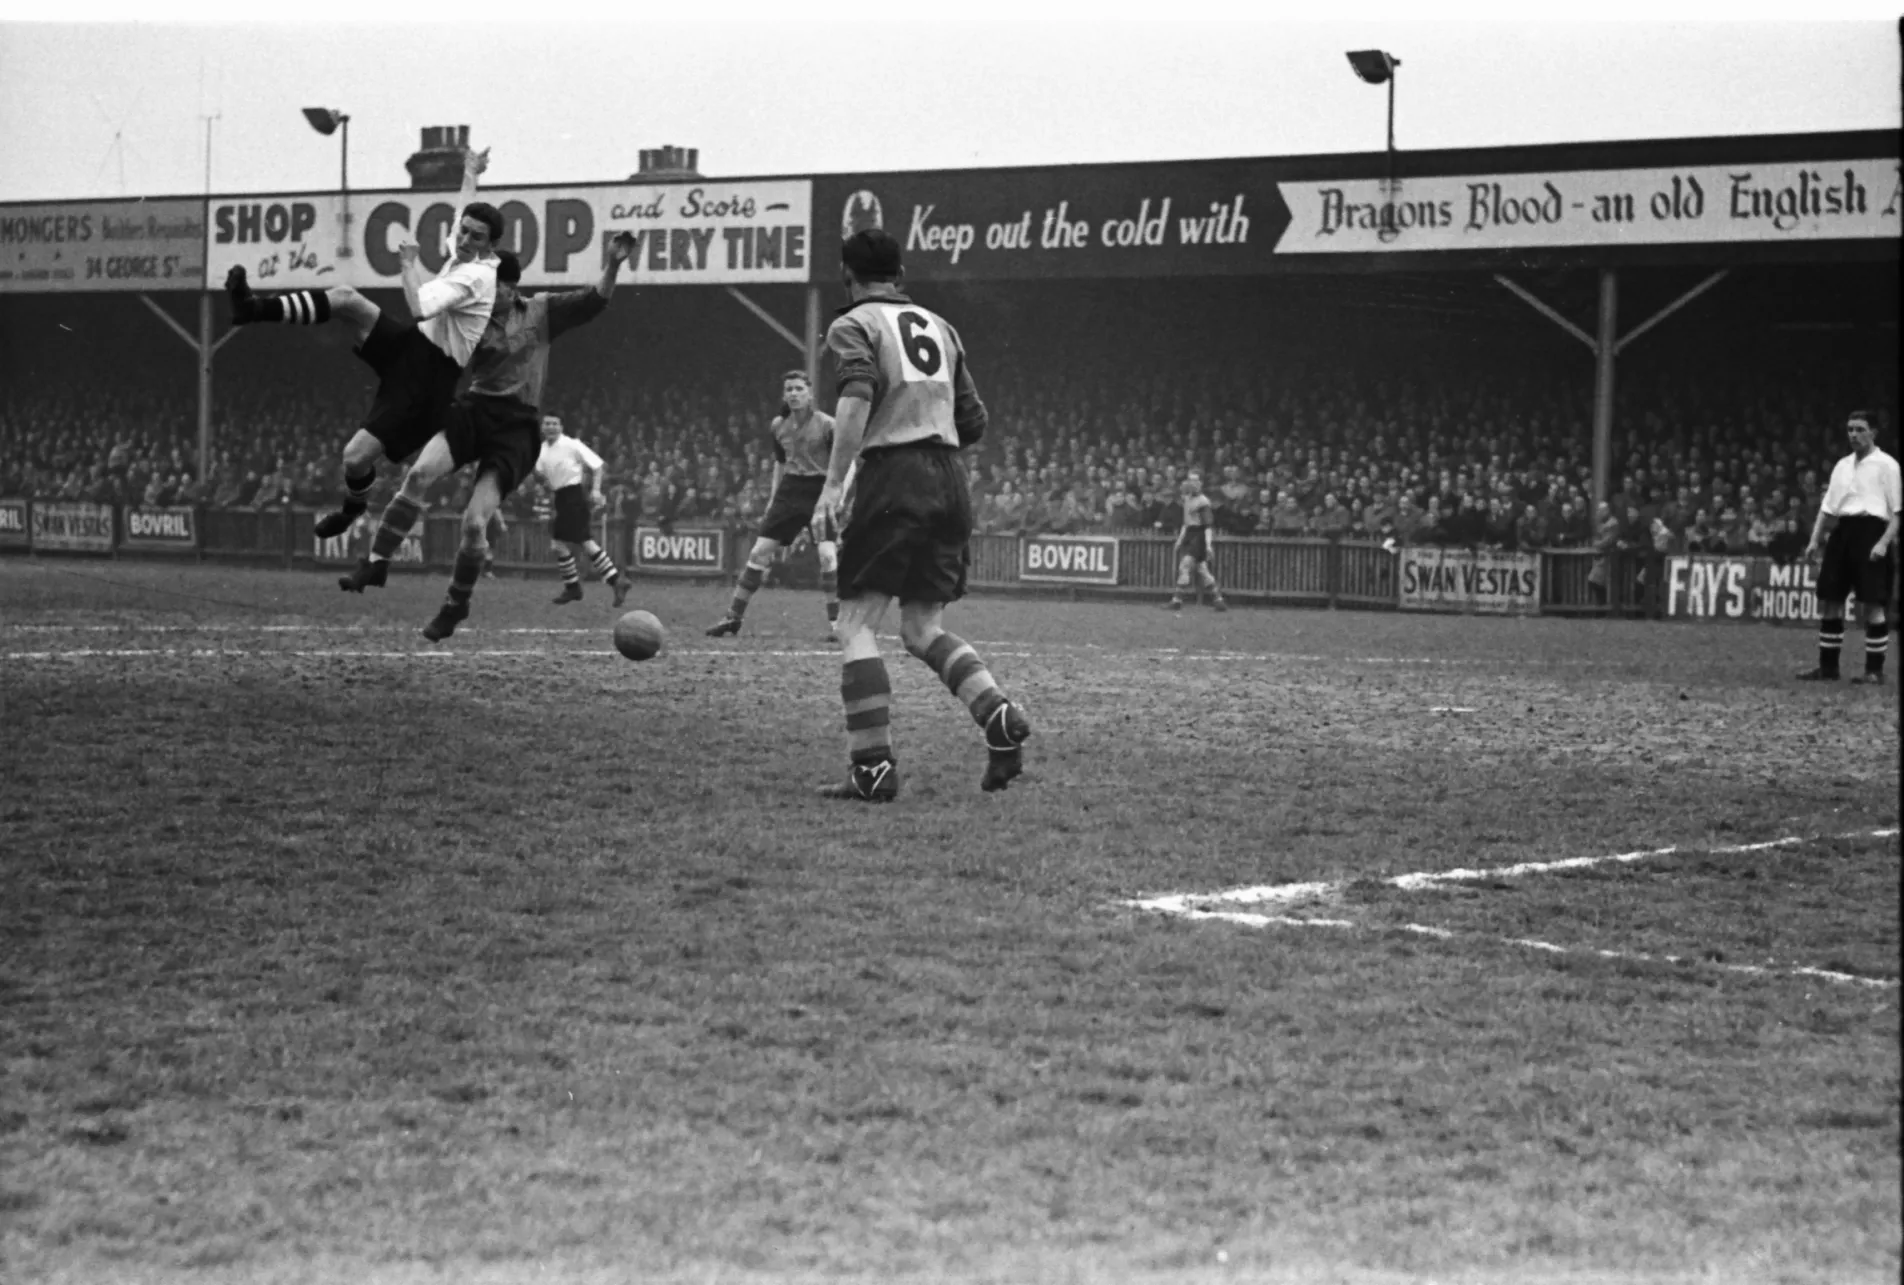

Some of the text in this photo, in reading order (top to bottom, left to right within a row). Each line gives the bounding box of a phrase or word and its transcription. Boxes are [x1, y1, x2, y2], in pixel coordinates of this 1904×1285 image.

[610, 192, 666, 219] and
[680, 188, 756, 219] Score
[1315, 188, 1453, 243] Dragons
[1464, 181, 1563, 234] Blood
[1650, 175, 1704, 220] old
[1729, 168, 1867, 230] English
[215, 202, 316, 243] SHOP
[906, 194, 1250, 264] Keep out the cold with
[258, 253, 280, 279] at
[288, 242, 318, 270] the
[722, 226, 804, 269] TIME
[897, 311, 941, 376] 6
[130, 513, 189, 537] BOVRIL
[643, 536, 716, 561] BOVRIL
[1028, 544, 1109, 572] BOVRIL
[1404, 560, 1536, 597] SWAN VESTAS
[1668, 559, 1746, 618] FRY'S
[1769, 563, 1818, 589] MIL
[1750, 586, 1857, 621] CHOCOLE
